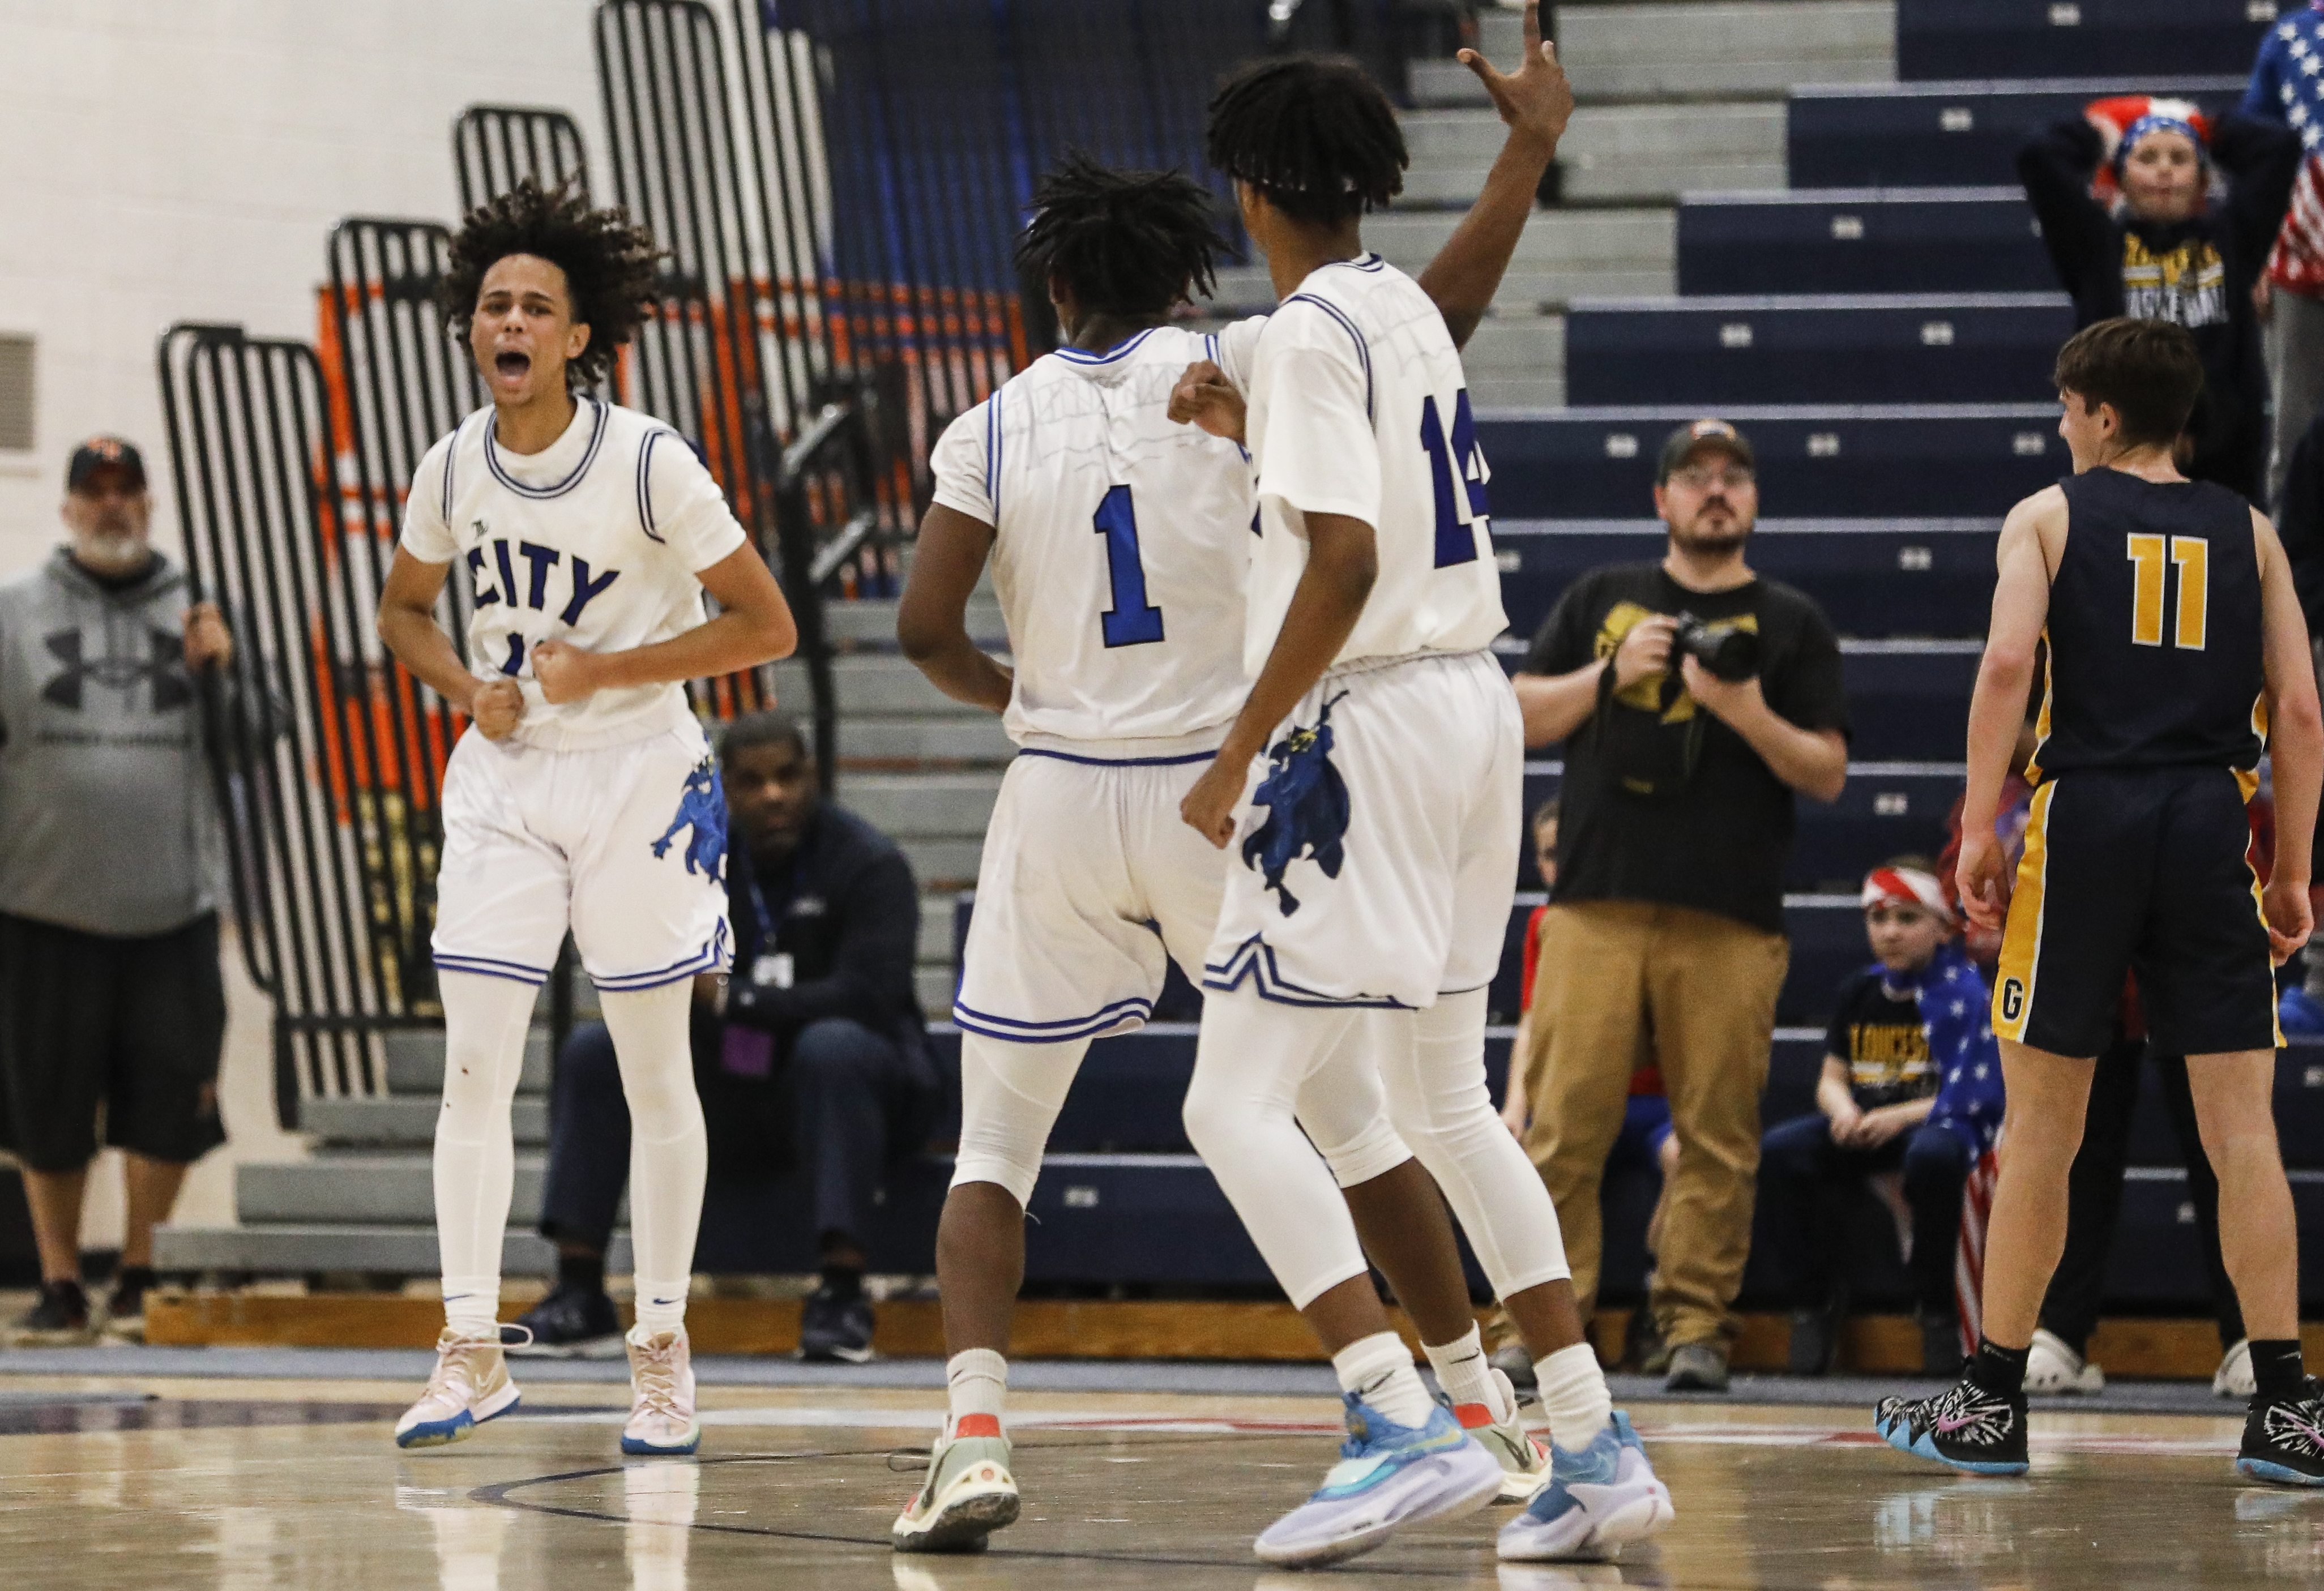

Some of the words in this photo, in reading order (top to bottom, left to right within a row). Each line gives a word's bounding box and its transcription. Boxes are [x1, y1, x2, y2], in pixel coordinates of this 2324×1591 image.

[1420, 388, 1496, 570] 14
[467, 539, 621, 627] CITY
[1093, 483, 1165, 648] 1
[2127, 532, 2208, 651] 11
[2002, 976, 2024, 1023] G
